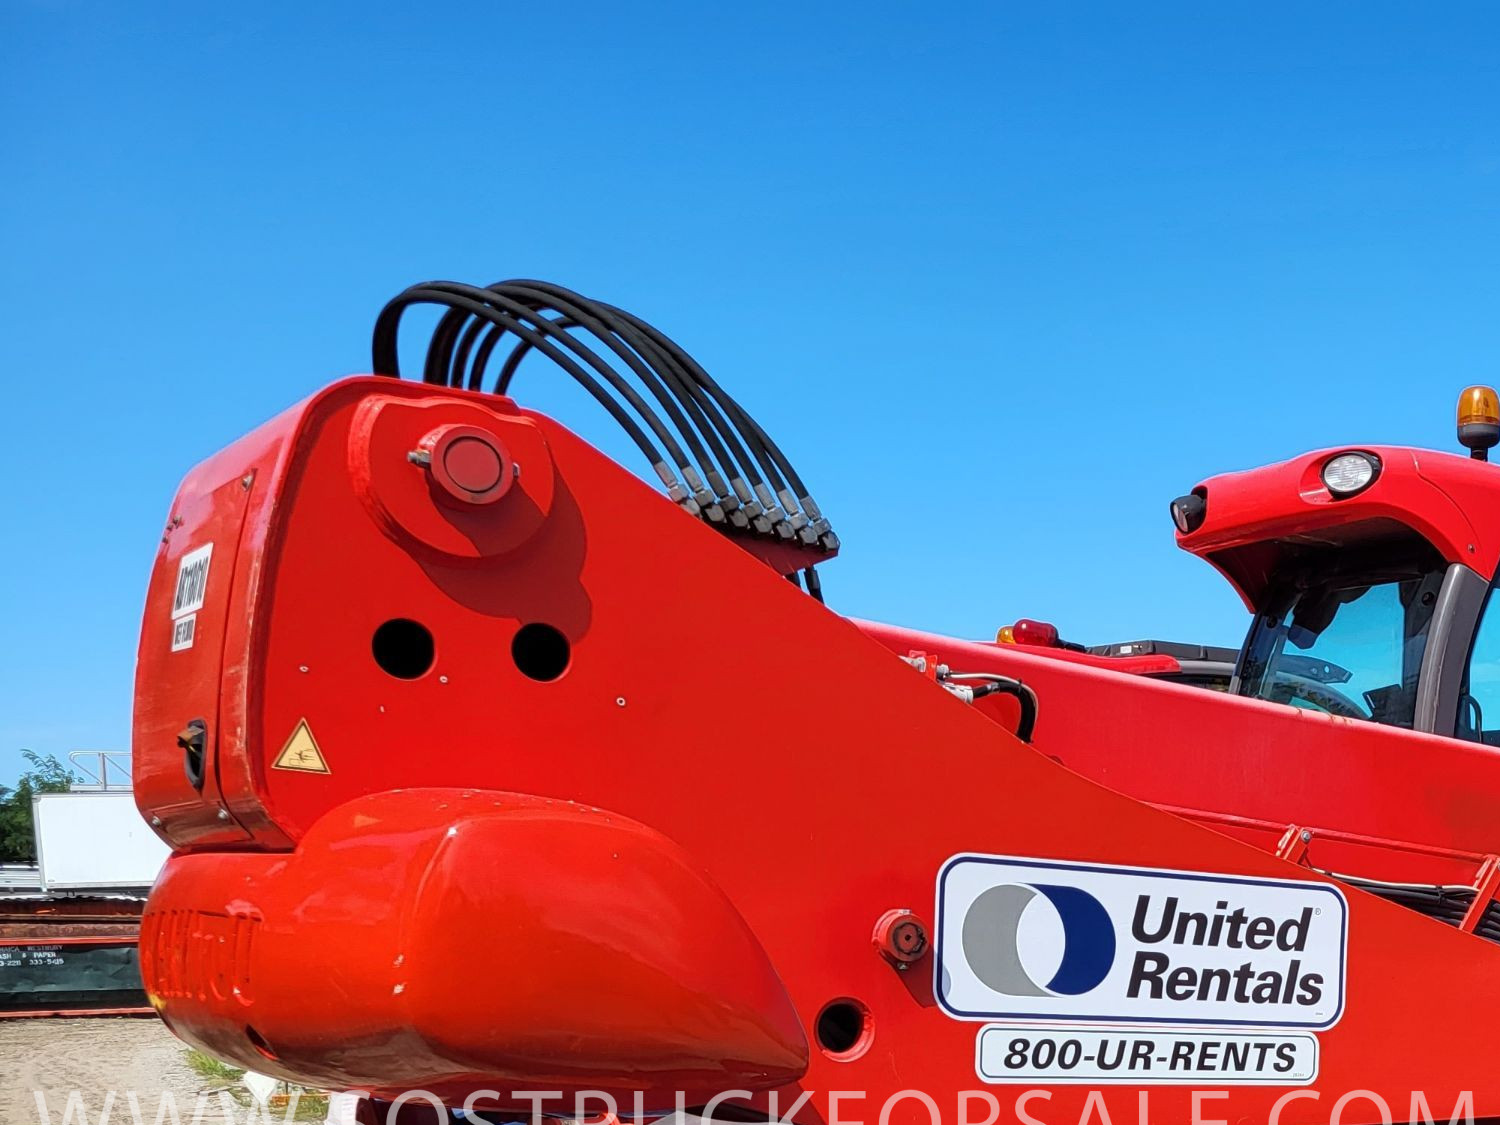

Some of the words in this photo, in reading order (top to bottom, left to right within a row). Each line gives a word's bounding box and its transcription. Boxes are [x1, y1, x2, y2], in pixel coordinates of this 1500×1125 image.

[1130, 893, 1313, 953] United
[1126, 950, 1324, 1007] Rentals
[1002, 1037, 1297, 1073] 800-UR-RENTS
